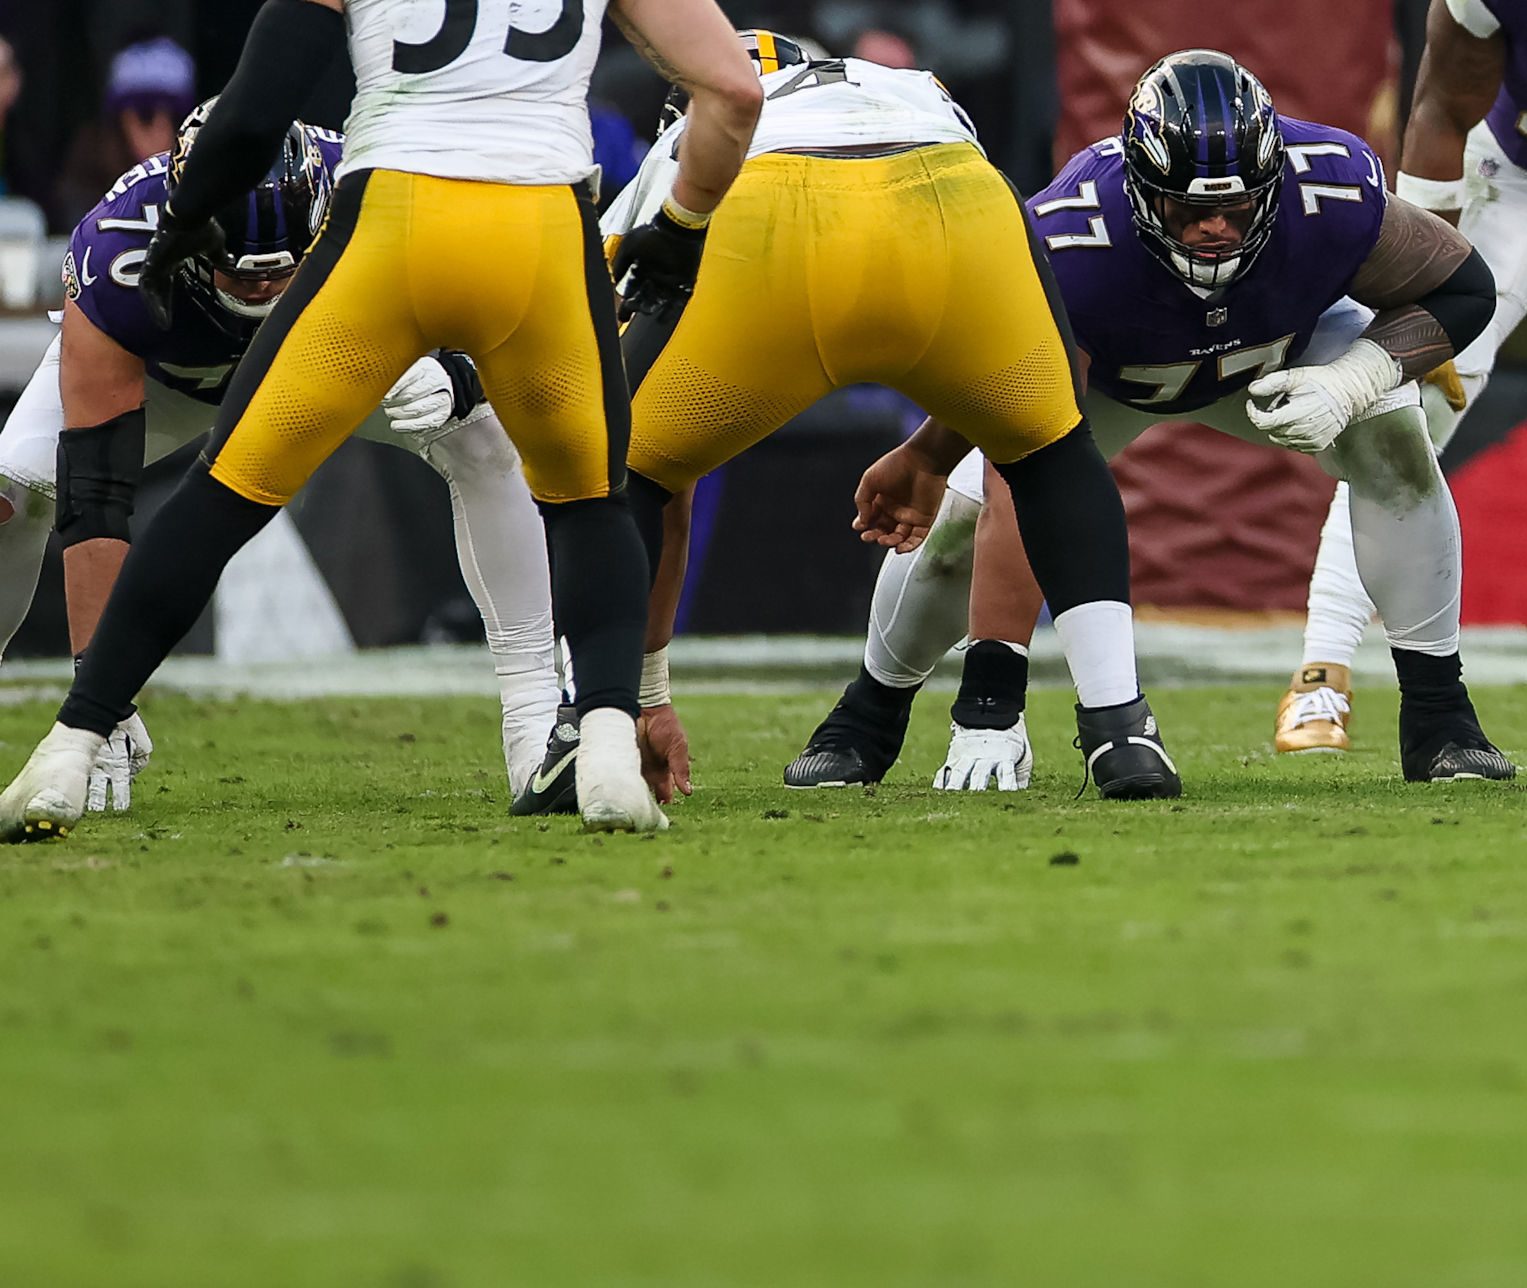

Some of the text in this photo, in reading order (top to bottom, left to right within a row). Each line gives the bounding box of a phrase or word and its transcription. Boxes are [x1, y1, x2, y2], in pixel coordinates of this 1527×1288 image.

[1034, 179, 1113, 251] 77
[1284, 142, 1363, 216] 77
[1188, 338, 1242, 356] RAVENS
